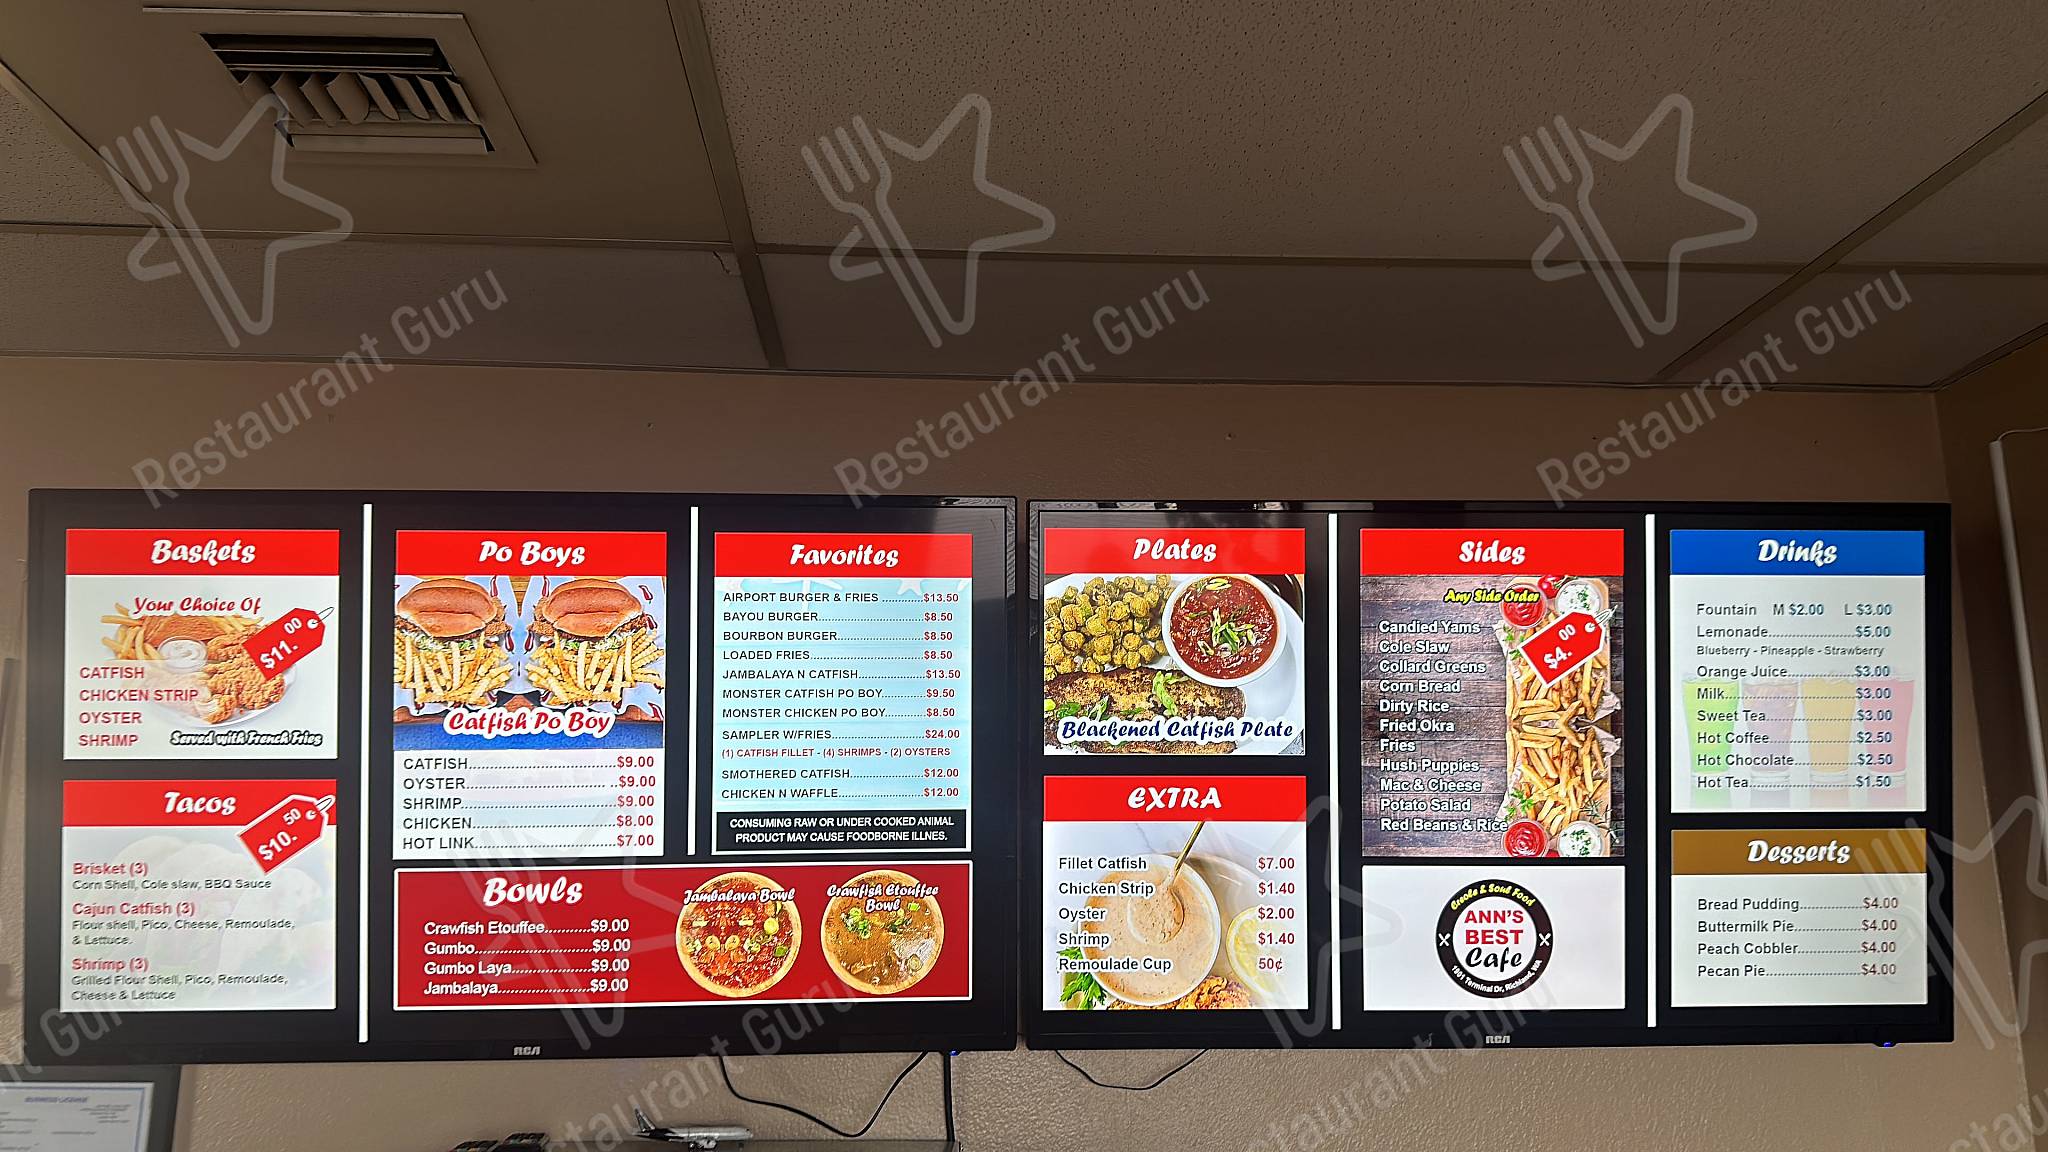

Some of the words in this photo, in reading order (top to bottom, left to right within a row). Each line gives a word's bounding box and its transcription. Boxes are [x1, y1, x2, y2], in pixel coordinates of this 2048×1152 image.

[150, 539, 256, 566] Baskets
[478, 540, 512, 562] Po
[520, 540, 586, 568] Boys
[790, 544, 898, 568] Favorites
[1133, 538, 1217, 562] Plates
[1458, 540, 1526, 565] Sides
[1758, 539, 1837, 567] Drinks
[724, 592, 776, 602] AIRPORT
[780, 592, 830, 602] BURGER
[834, 592, 842, 602] &
[845, 592, 878, 602] FRIES
[923, 593, 959, 603] $13.50
[1444, 588, 1472, 603] Any
[1474, 588, 1502, 602] Side
[1504, 588, 1540, 602] Order
[132, 597, 174, 614] Your
[179, 597, 235, 612] Choice
[240, 597, 261, 615] Of
[1697, 604, 1757, 615] Fountain
[1773, 604, 1784, 615] M
[1789, 603, 1824, 615] $2.00
[1844, 604, 1852, 615] L
[1856, 604, 1892, 615] $3.00
[283, 617, 302, 635] 00
[1378, 620, 1440, 634] Candied
[1442, 622, 1480, 634] Yams
[1558, 624, 1576, 642] 00
[1697, 626, 1768, 637] Lemonade
[1855, 626, 1891, 638] $5.00
[259, 639, 299, 671] $11.
[723, 650, 772, 660] LOADED
[776, 650, 810, 660] FRIES
[924, 650, 952, 660] $8.50
[79, 666, 144, 679] CATFISH
[1379, 660, 1431, 673] Collard
[1434, 662, 1486, 674] Greens
[79, 689, 149, 702] CHICKEN
[153, 689, 199, 702] STRIP
[79, 712, 142, 725] OYSTER
[448, 712, 526, 734] Catfish
[533, 712, 560, 729] Po
[568, 712, 610, 734] Boy
[722, 730, 780, 740] SAMPLER
[782, 729, 832, 740] W/FRIES
[925, 729, 960, 739] $24.00
[1062, 721, 1160, 740] Blackened
[1167, 722, 1234, 740] Catfish
[1240, 722, 1293, 736] Plate
[78, 734, 138, 747] SHRIMP
[171, 731, 213, 746] Served
[216, 731, 245, 746] with
[246, 731, 290, 746] French
[291, 731, 322, 746] Fries
[403, 758, 468, 770] CATFISH
[616, 756, 654, 768] $9.00
[1380, 780, 1410, 792] Mac
[1414, 780, 1424, 792] &
[1428, 780, 1481, 792] Cheese
[164, 791, 236, 816] Tacos
[1128, 787, 1222, 812] EXTRA
[282, 808, 302, 826] 50
[402, 818, 472, 830] CHICKEN
[616, 815, 654, 828] $8.00
[730, 817, 792, 828] CONSUMING
[793, 817, 816, 827] RAW
[818, 817, 834, 827] OR
[836, 817, 872, 827] UNDER
[873, 817, 916, 827] COOKED
[917, 816, 954, 826] ANIMAL
[1380, 819, 1410, 831] Red
[1413, 819, 1458, 832] Beans
[1462, 820, 1472, 832] &
[1476, 819, 1508, 832] Rice
[402, 838, 434, 850] HOT
[439, 836, 474, 849] LINK
[616, 834, 654, 847] $7.00
[735, 832, 786, 843] PRODUCT
[787, 831, 807, 842] MAY
[809, 831, 844, 841] CAUSE
[846, 831, 910, 841] FOODBORNE
[912, 830, 948, 841] ILLNES.
[258, 831, 298, 861] $10.
[1747, 840, 1850, 865] Desserts
[72, 862, 126, 876] Brisket
[129, 862, 148, 877] (3)
[1058, 858, 1094, 869] Fillet
[1097, 858, 1147, 870] Catfish
[1258, 858, 1295, 870] $7.00
[72, 879, 102, 890] Corn
[104, 879, 138, 891] Shell,
[141, 879, 168, 890] Cole
[170, 879, 201, 891] slaw,
[204, 879, 232, 890] BBQ
[234, 879, 271, 890] Sauce
[483, 876, 582, 906] Bowls
[827, 884, 883, 898] Crawfish
[885, 884, 939, 897] Etouffee
[1058, 882, 1116, 894] Chicken
[1120, 882, 1154, 898] Strip
[1258, 882, 1295, 895] $1.40
[684, 889, 759, 903] Jambalaya
[760, 888, 796, 901] Bowl
[1451, 887, 1478, 910] Creole
[1479, 884, 1487, 894] &
[1488, 884, 1512, 894] Soul
[1512, 887, 1536, 907] Food
[72, 902, 116, 918] Cajun
[119, 902, 172, 916] Catfish
[176, 902, 195, 917] (3)
[865, 898, 900, 912] Bowl
[1698, 898, 1738, 911] Bread
[1742, 898, 1799, 913] Pudding
[1863, 897, 1898, 910] $4.00
[1058, 908, 1106, 922] Oyster
[1258, 908, 1295, 920] $2.00
[1464, 910, 1524, 923] ANN'S
[424, 921, 484, 935] Crawfish
[488, 920, 544, 934] Etouffee
[590, 919, 630, 932] $9.00
[1058, 933, 1110, 948] Shrimp
[1258, 933, 1295, 945] $1.40
[1466, 930, 1523, 944] BEST
[424, 942, 475, 956] Gumbo
[592, 939, 630, 952] $9.00
[71, 958, 126, 973] Shrimp
[129, 958, 148, 972] (3)
[1059, 958, 1138, 970] Remoulade
[1142, 958, 1172, 973] Cup
[1258, 958, 1283, 970] 50¢
[1466, 947, 1522, 972] Cafe
[71, 974, 112, 986] Grilled
[114, 974, 145, 985] Flour
[148, 973, 182, 986] Shell,
[184, 973, 215, 986] Pico,
[218, 972, 288, 986] Remoulade,
[1465, 976, 1493, 993] Terminal
[1532, 959, 1542, 972] WA
[71, 989, 116, 1001] Cheese
[119, 989, 128, 1001] &
[131, 989, 176, 1001] Lettuce
[1486, 1035, 1510, 1043] RCA
[514, 1046, 541, 1056] RCA
